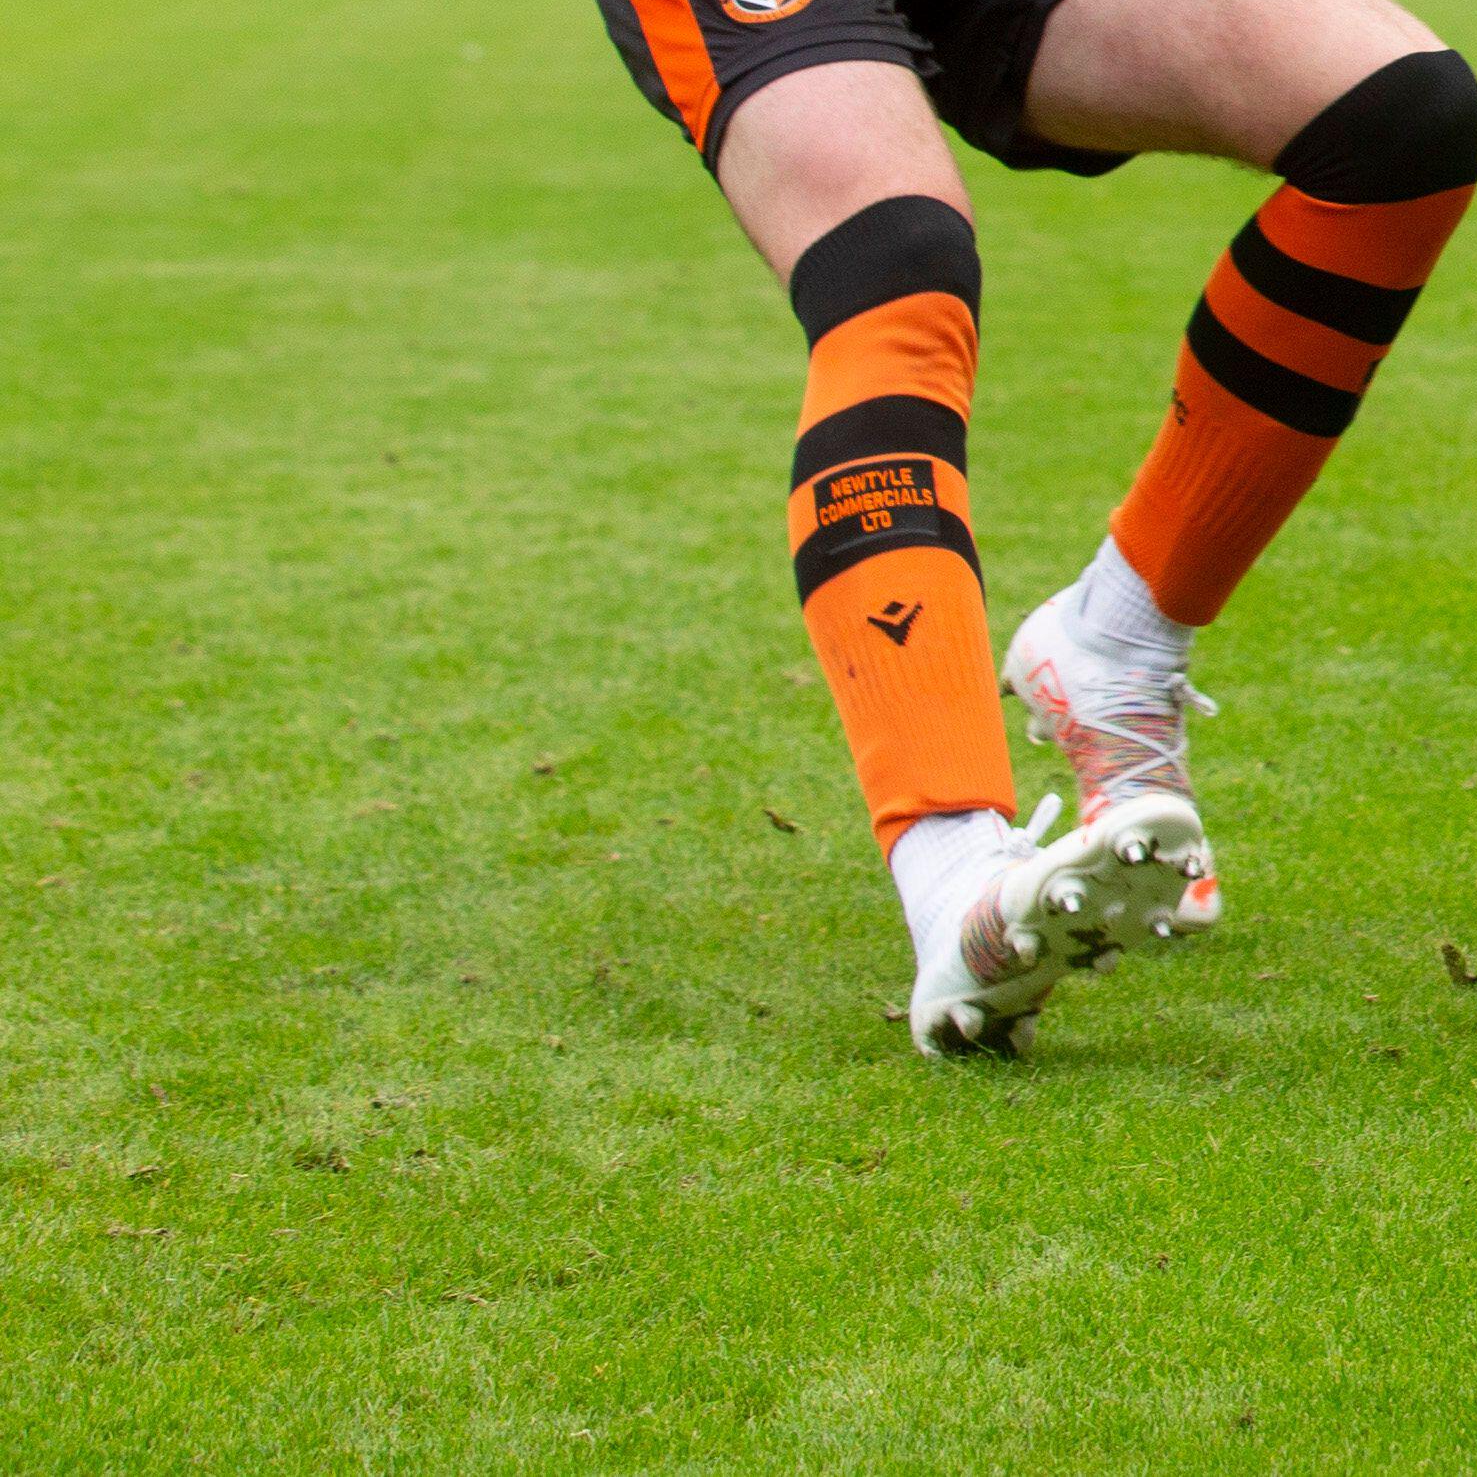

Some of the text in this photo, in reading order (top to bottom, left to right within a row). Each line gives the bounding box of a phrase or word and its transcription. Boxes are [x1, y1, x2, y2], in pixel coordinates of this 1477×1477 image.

[830, 467, 914, 499] NEWTYLE
[819, 488, 934, 526] COMMERCIALS
[861, 509, 892, 533] LTD
